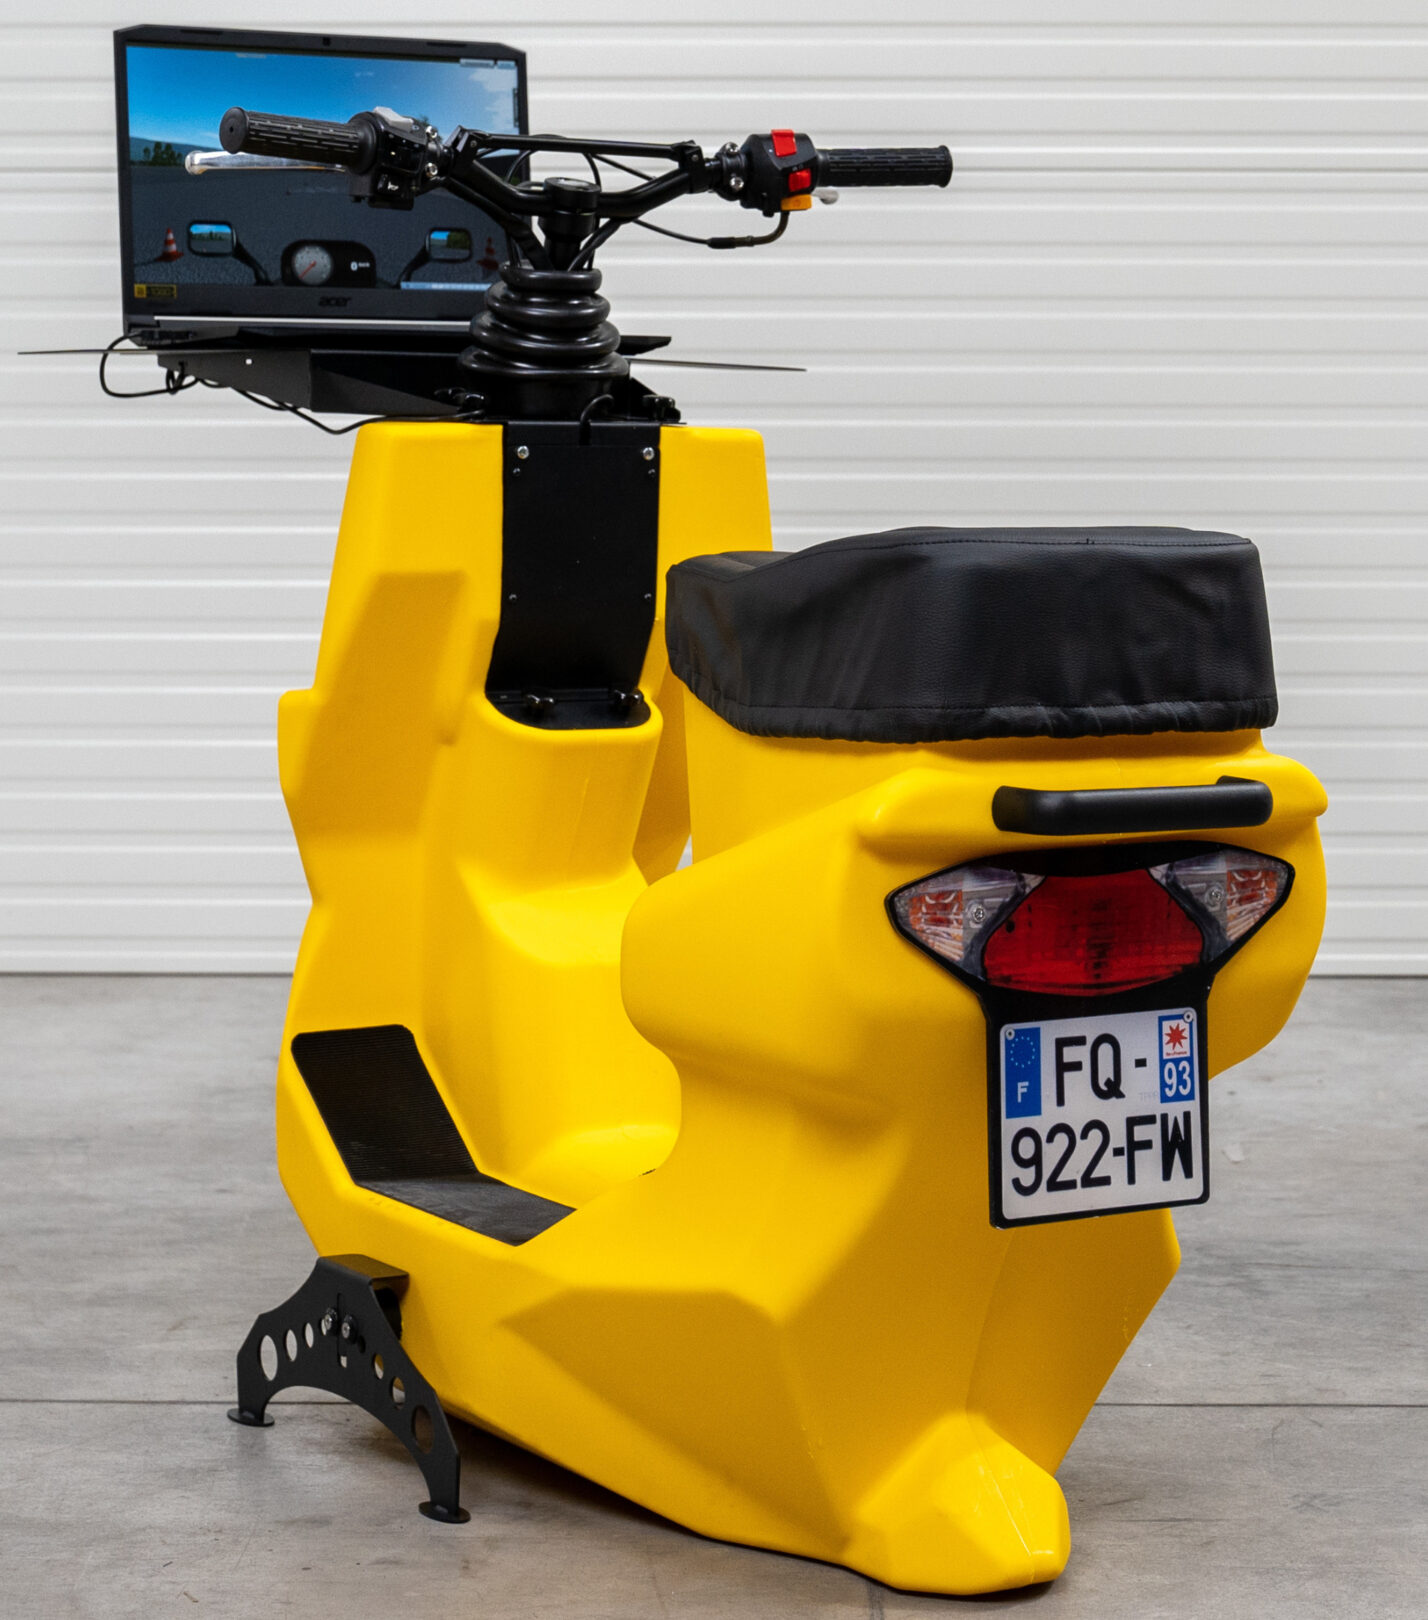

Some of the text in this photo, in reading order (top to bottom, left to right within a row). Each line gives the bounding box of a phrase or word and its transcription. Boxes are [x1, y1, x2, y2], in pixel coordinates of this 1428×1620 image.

[319, 297, 351, 307] acer
[1017, 1081, 1029, 1103] F
[1163, 1060, 1192, 1098] 93
[1011, 1110, 1194, 1197] 922-FW
